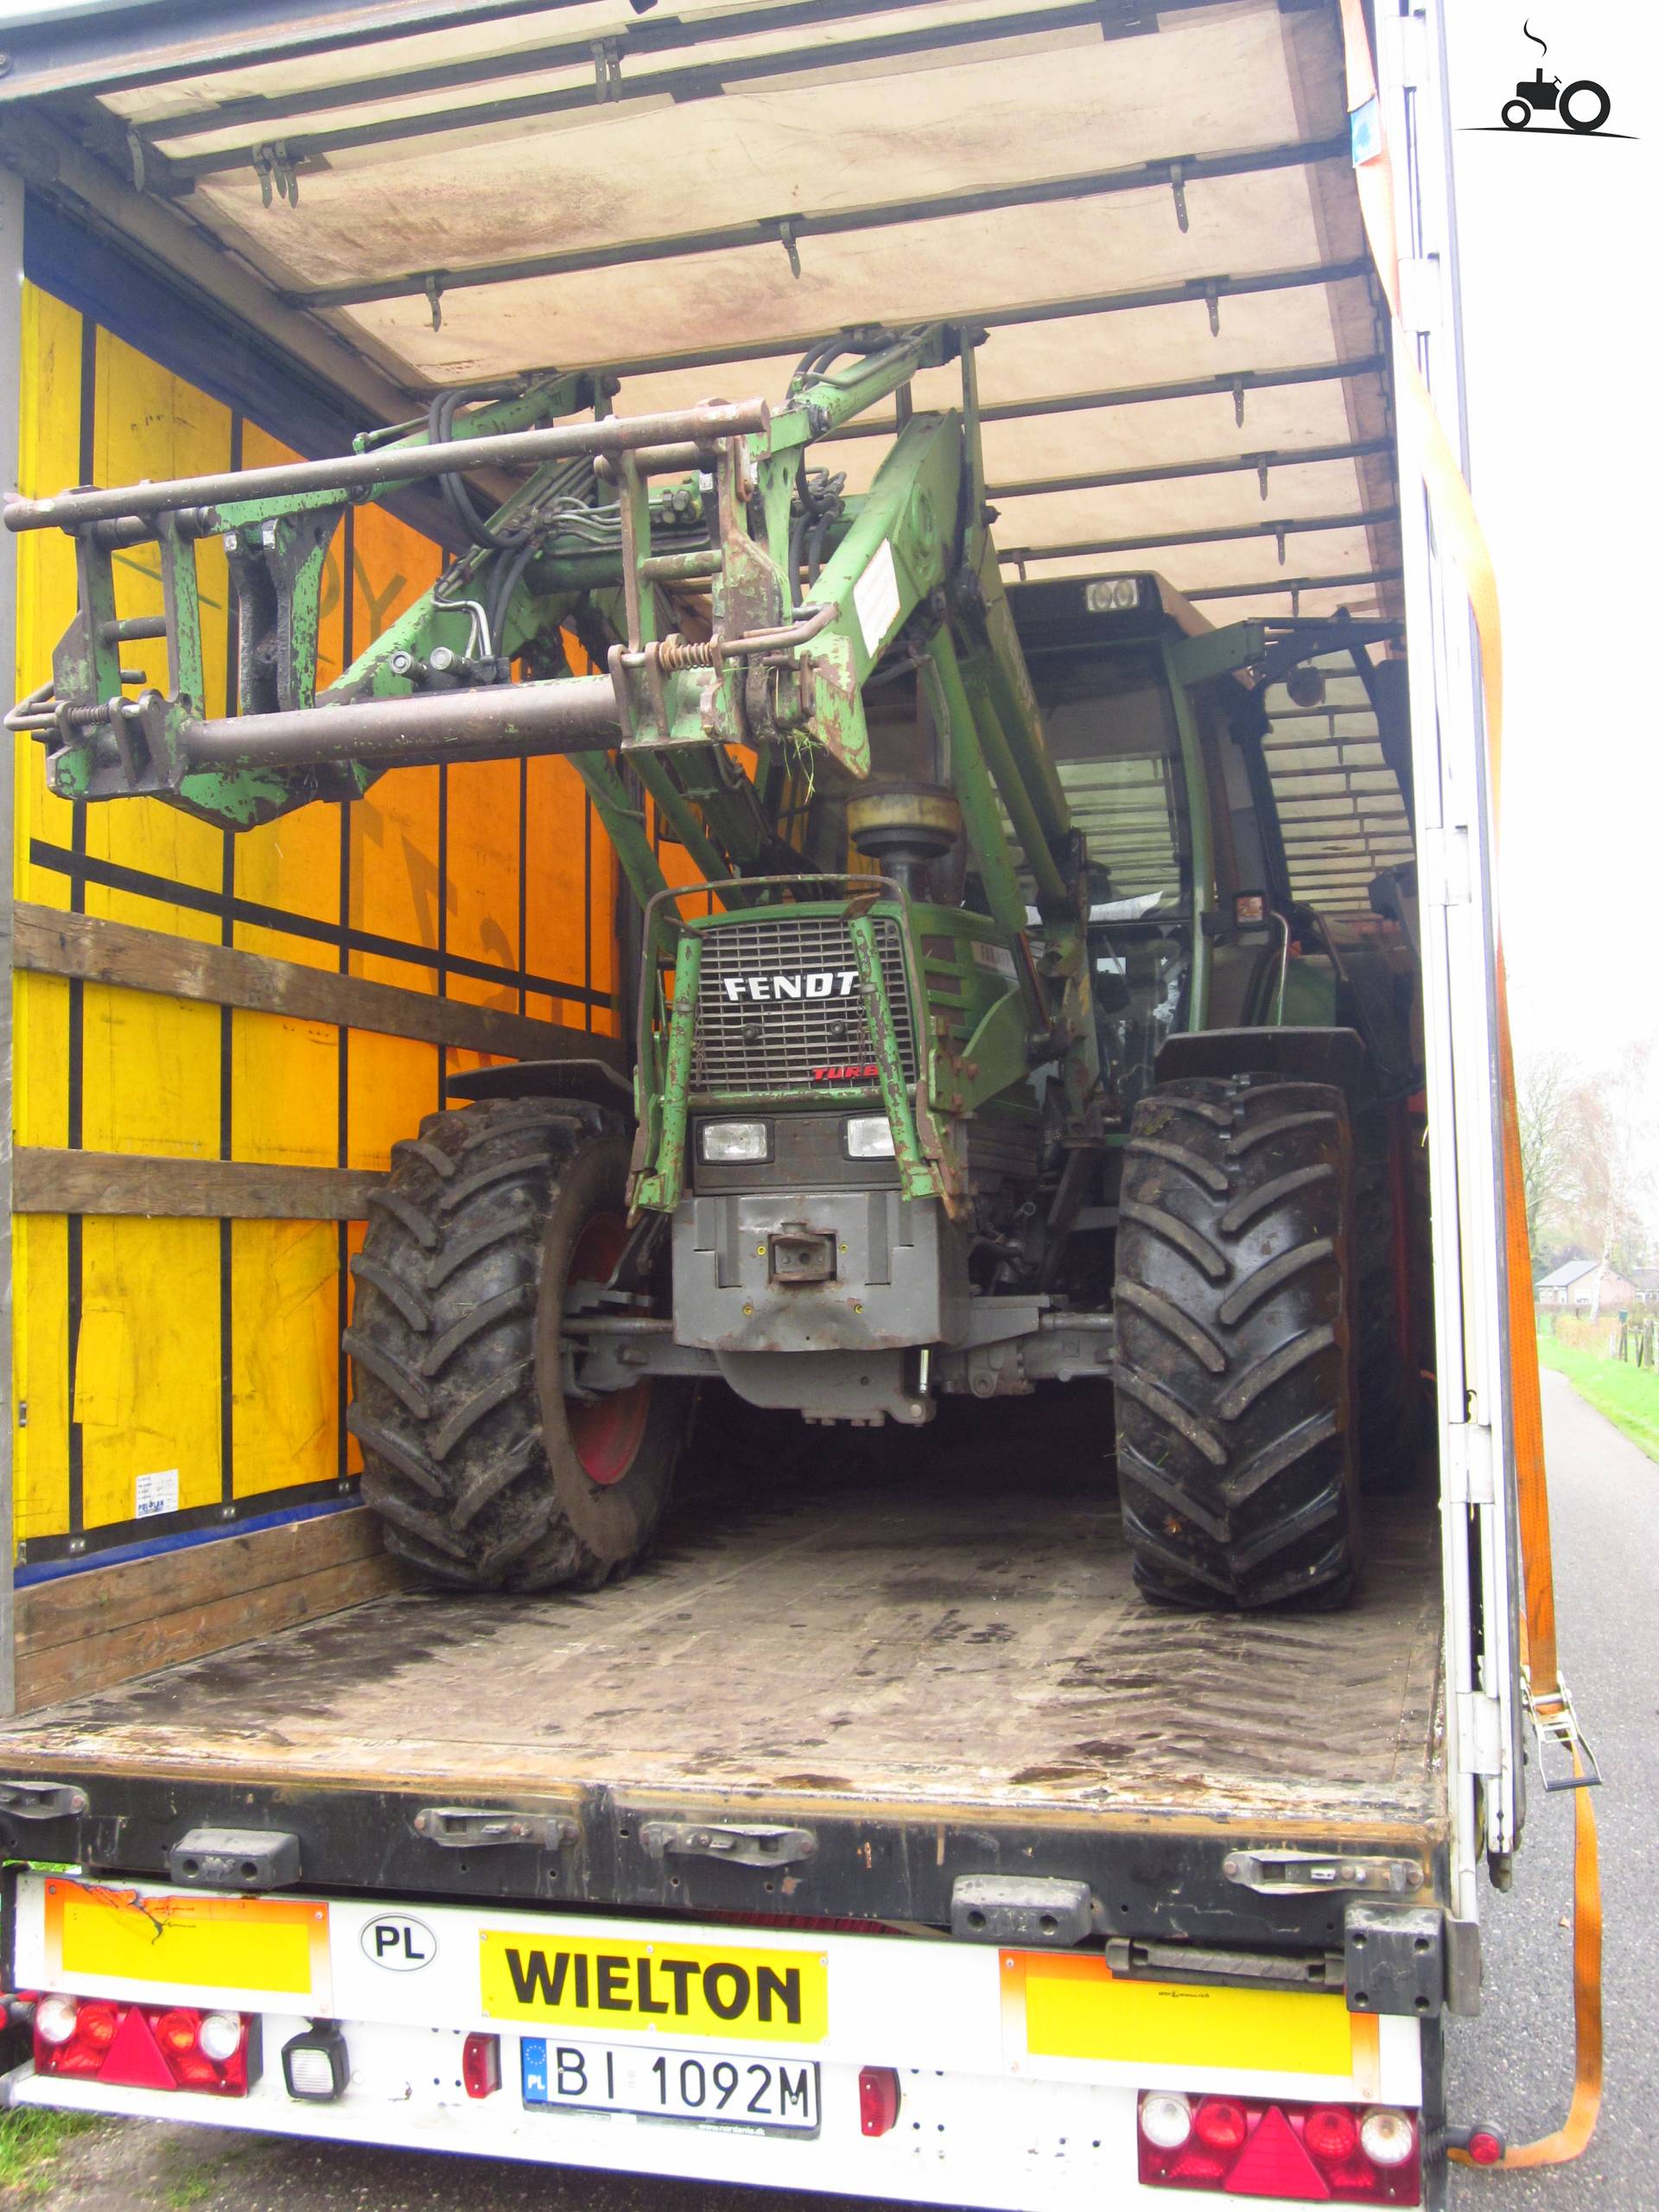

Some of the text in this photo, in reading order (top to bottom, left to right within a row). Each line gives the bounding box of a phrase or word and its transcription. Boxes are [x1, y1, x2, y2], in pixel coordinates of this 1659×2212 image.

[724, 971, 859, 1001] FENDT
[812, 1065, 880, 1080] TURB
[375, 1925, 425, 1959] PL
[505, 1948, 802, 2024] WIELTON
[528, 2075, 545, 2090] PL
[556, 2047, 809, 2117] BI 1092M
